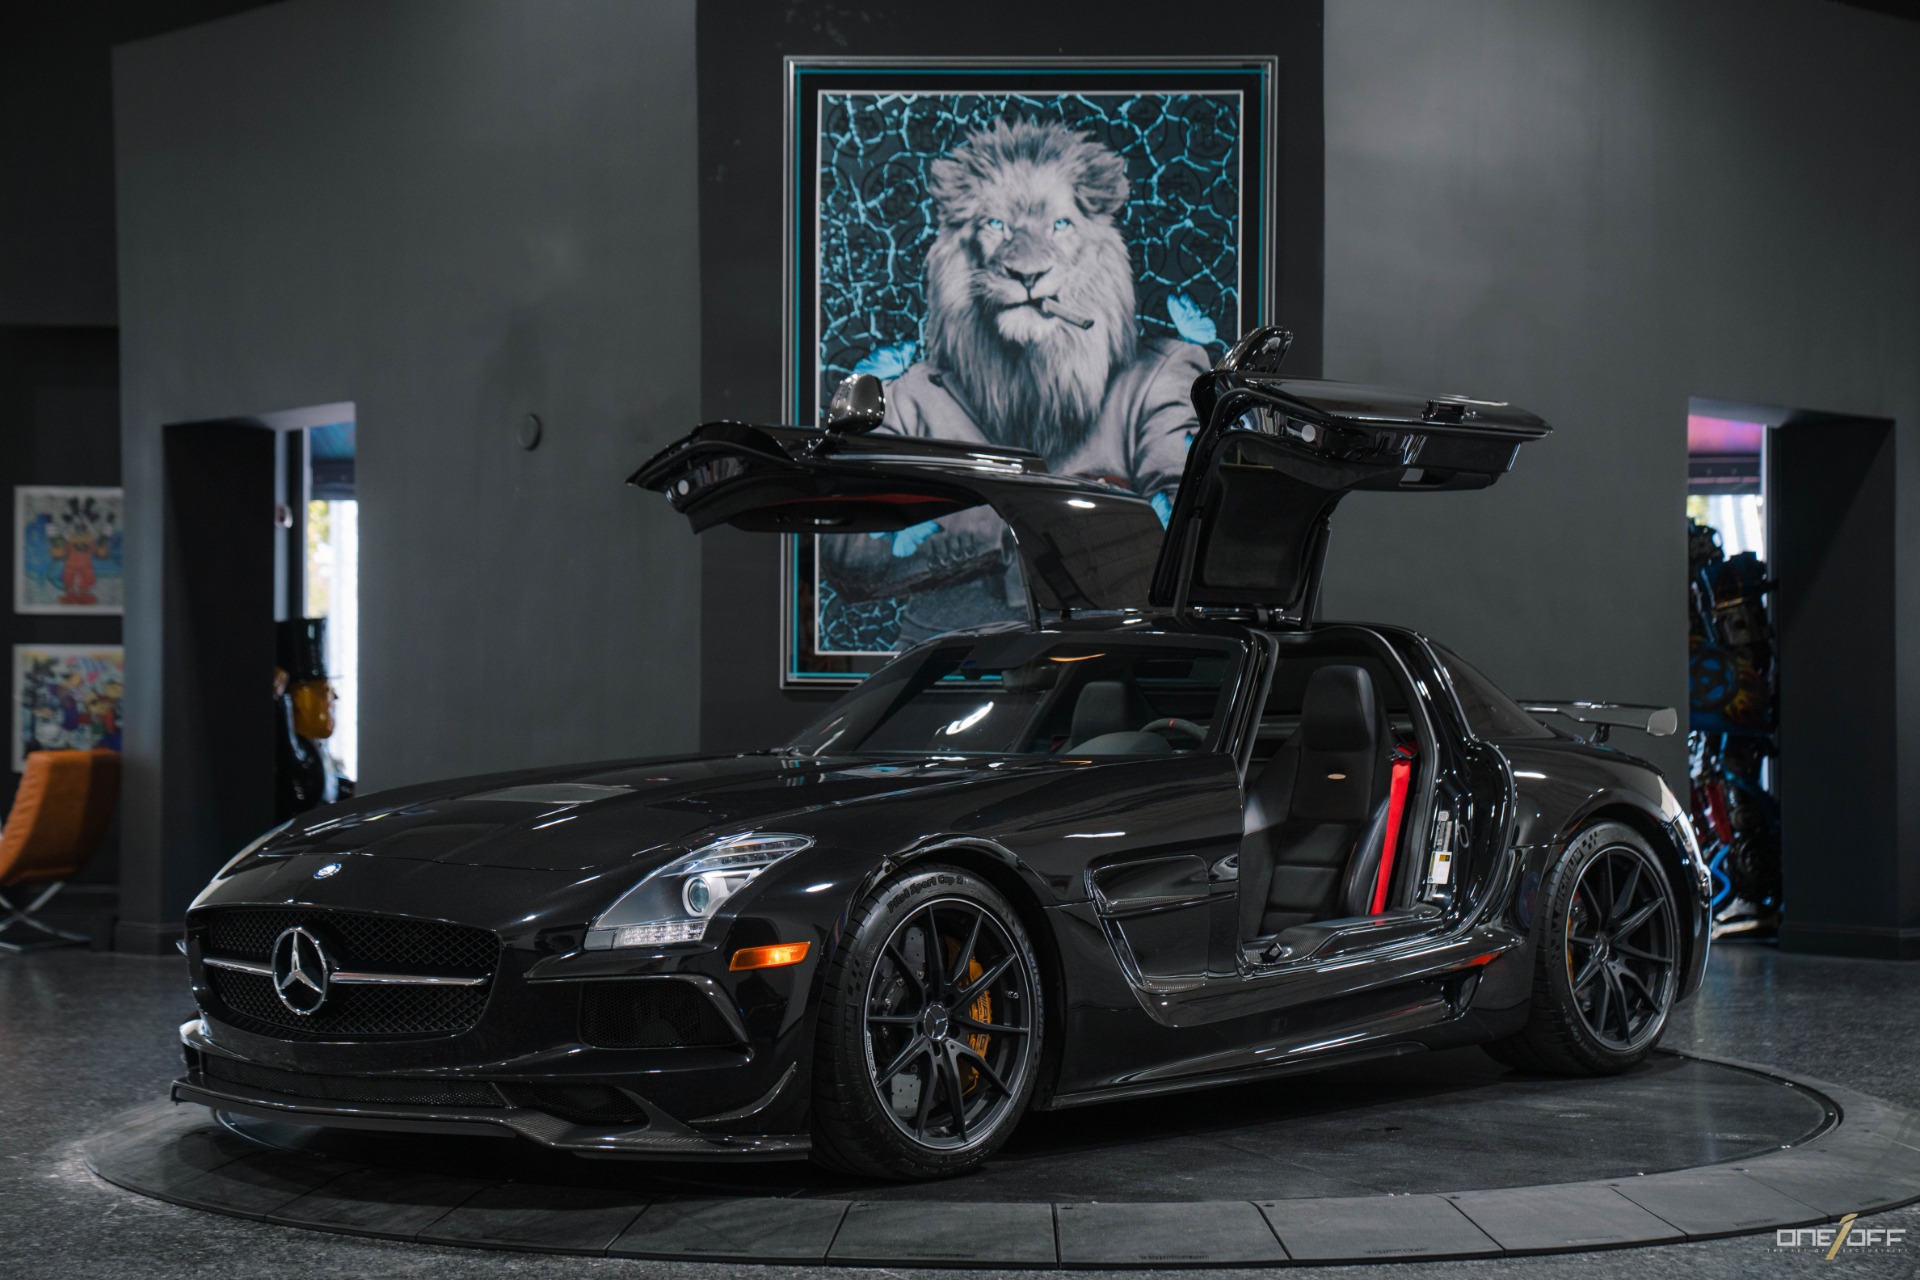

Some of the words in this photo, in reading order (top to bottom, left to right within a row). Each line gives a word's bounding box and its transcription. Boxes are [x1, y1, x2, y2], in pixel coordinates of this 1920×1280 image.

[910, 876, 937, 897] Sport
[938, 875, 955, 886] Cup
[956, 876, 963, 884] 2
